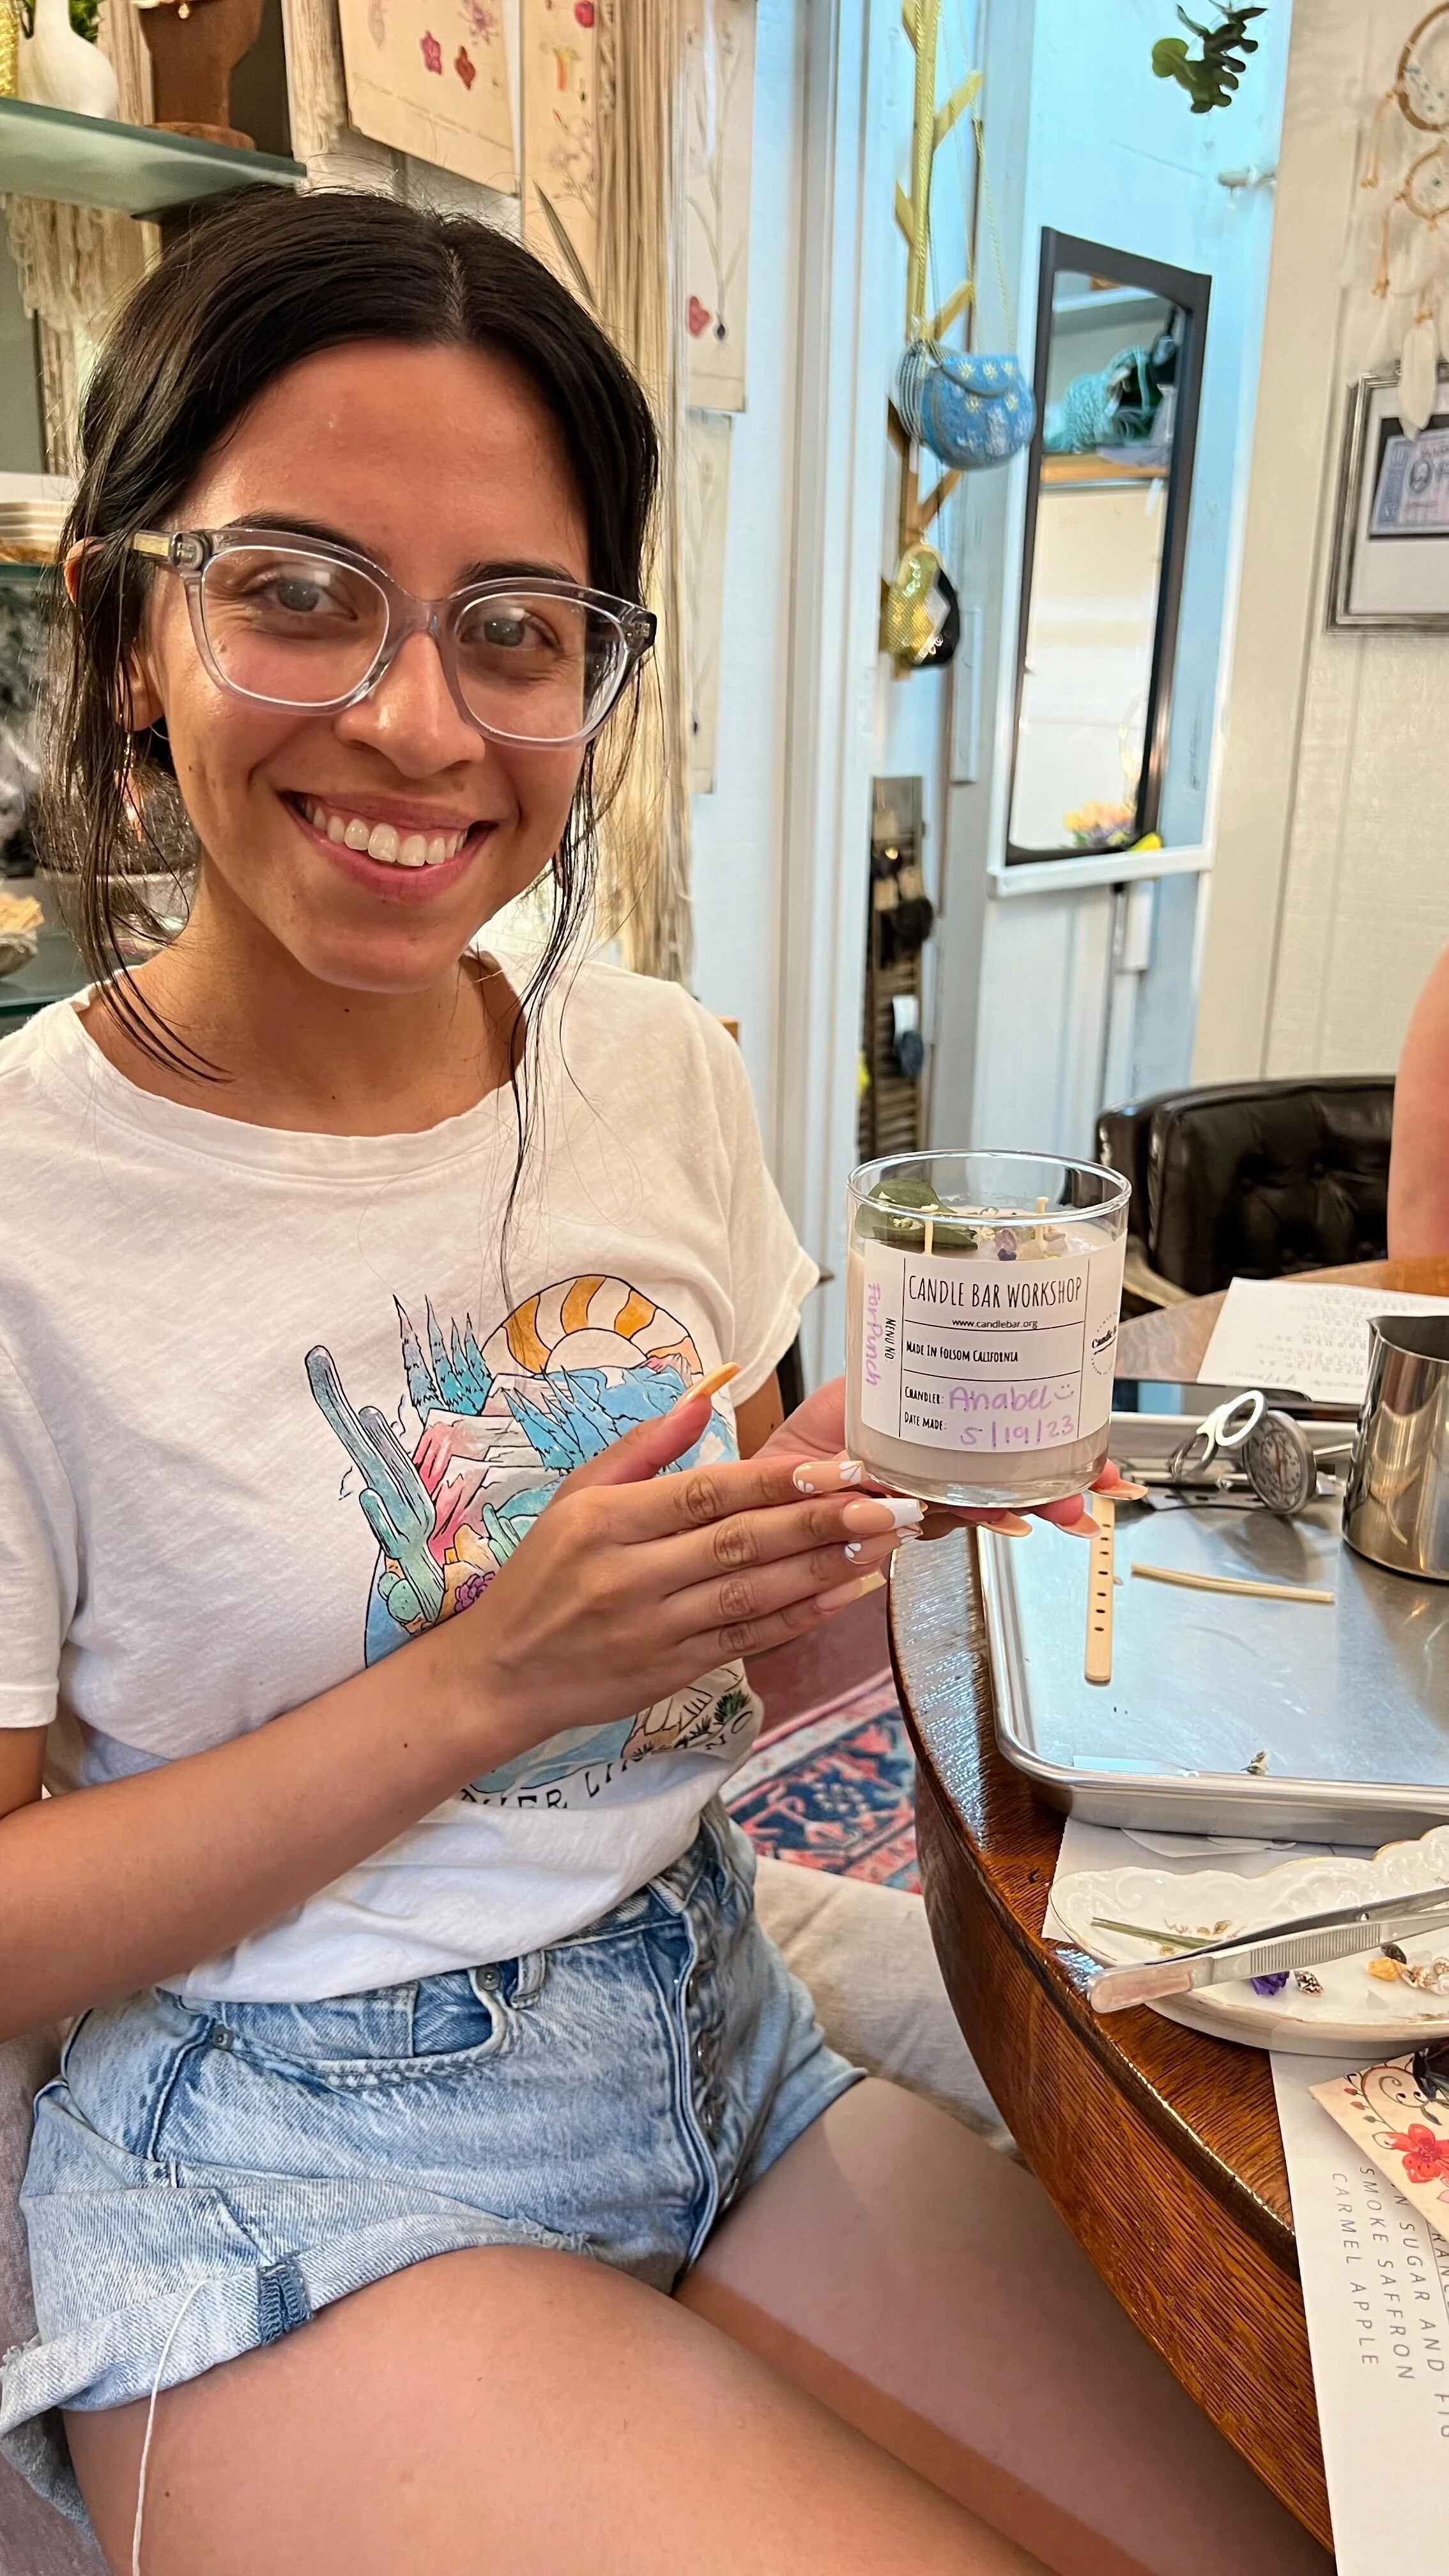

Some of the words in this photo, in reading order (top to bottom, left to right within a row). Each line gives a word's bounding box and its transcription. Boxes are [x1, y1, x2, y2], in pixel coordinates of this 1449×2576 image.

[909, 1275, 965, 1307] CANDLE
[972, 1284, 1000, 1308] BAR
[1007, 1276, 1082, 1308] WORKSHOP
[884, 1317, 896, 1345] MENU
[952, 1319, 1038, 1329] www.candlebar.org
[949, 1385, 1052, 1412] Anabel
[904, 1411, 920, 1426] DATE
[960, 1414, 1074, 1450] 5/19/23
[1332, 2172, 1362, 2264] CARMEL
[1349, 2281, 1379, 2365] APPLE
[1360, 2166, 1389, 2243] SMOKE
[1377, 2258, 1415, 2379] SAFFRON
[1399, 2221, 1430, 2301] SUGAR
[1418, 2319, 1445, 2372] AND
